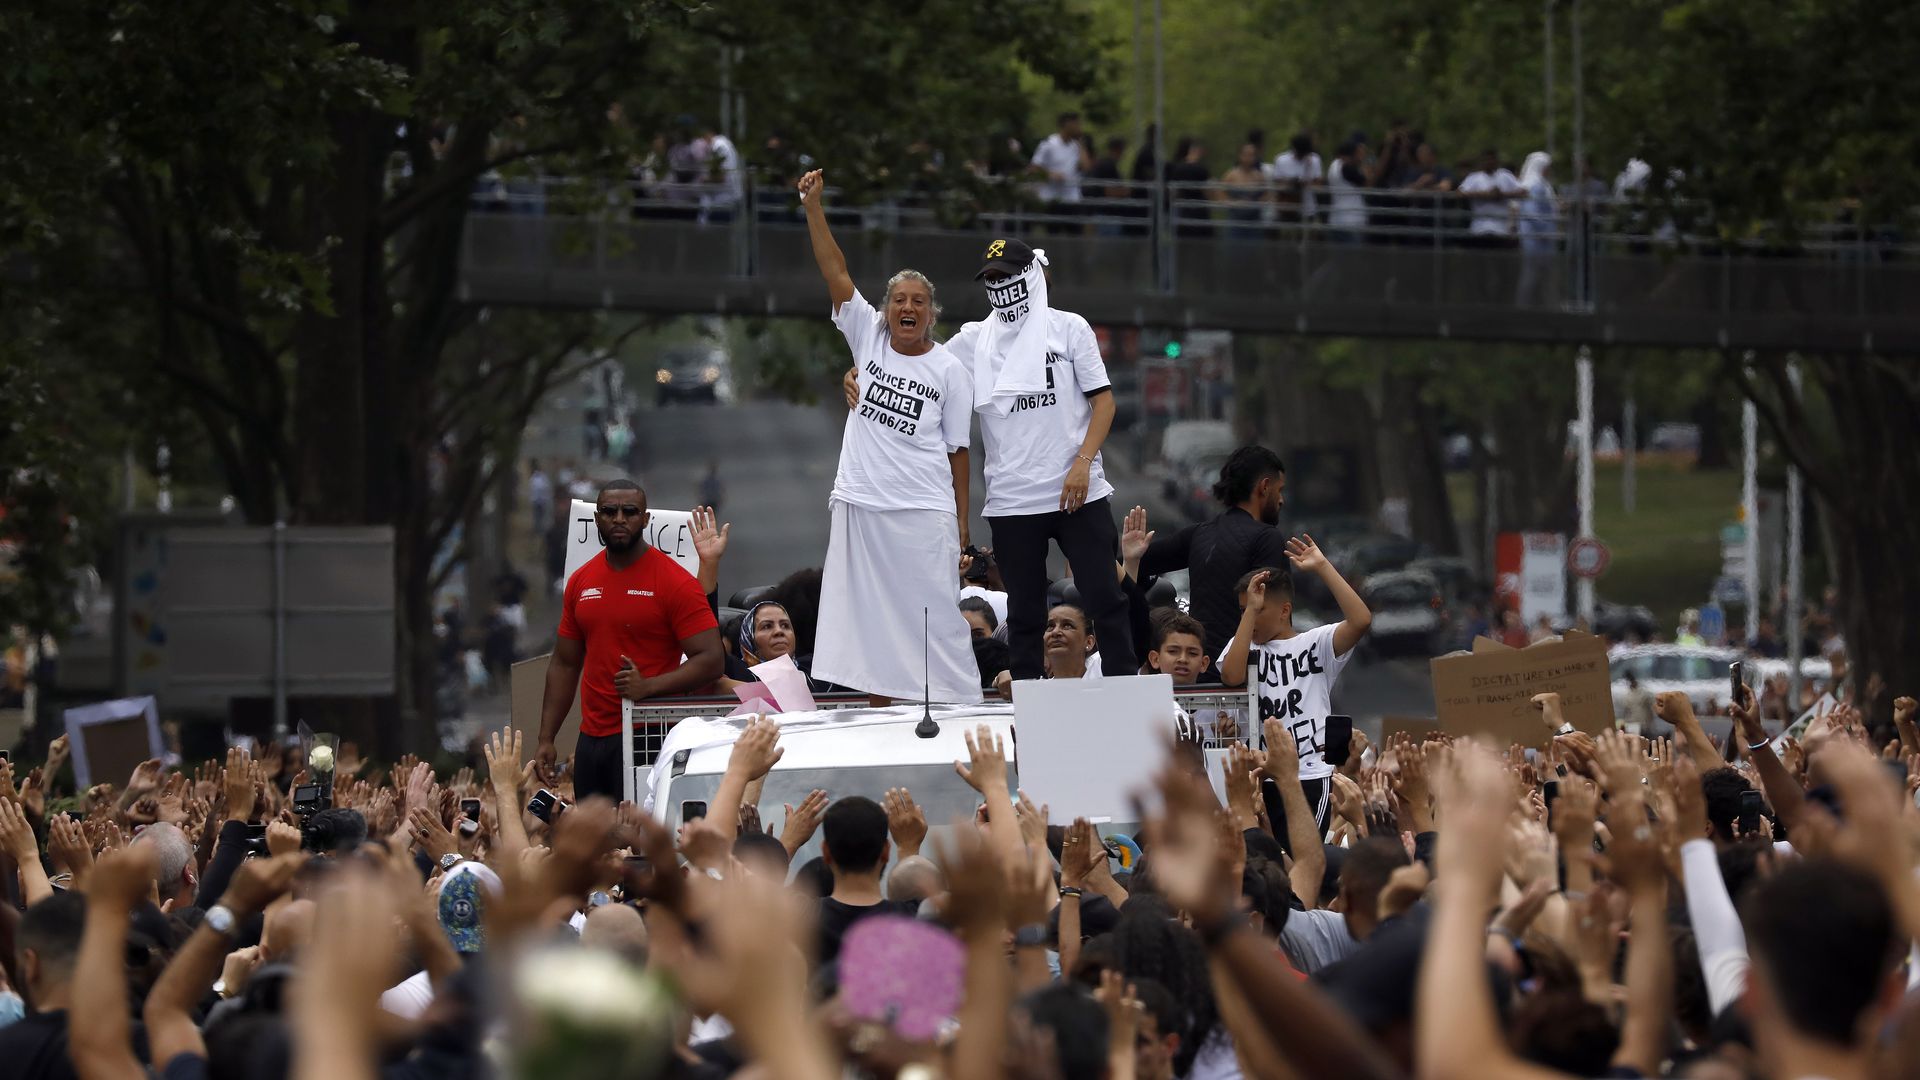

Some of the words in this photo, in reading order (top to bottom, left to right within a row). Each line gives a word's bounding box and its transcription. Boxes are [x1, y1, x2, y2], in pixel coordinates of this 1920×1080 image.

[865, 360, 906, 390] JUSTICE
[907, 380, 940, 402] POUR
[868, 383, 919, 417] NAHEL
[1010, 392, 1056, 412] /06/23
[860, 404, 917, 436] 27/06/23
[577, 516, 687, 558] JICE
[1257, 642, 1324, 687] USTICE
[1471, 671, 1544, 688] DICTATURE
[1258, 689, 1304, 723] OUR
